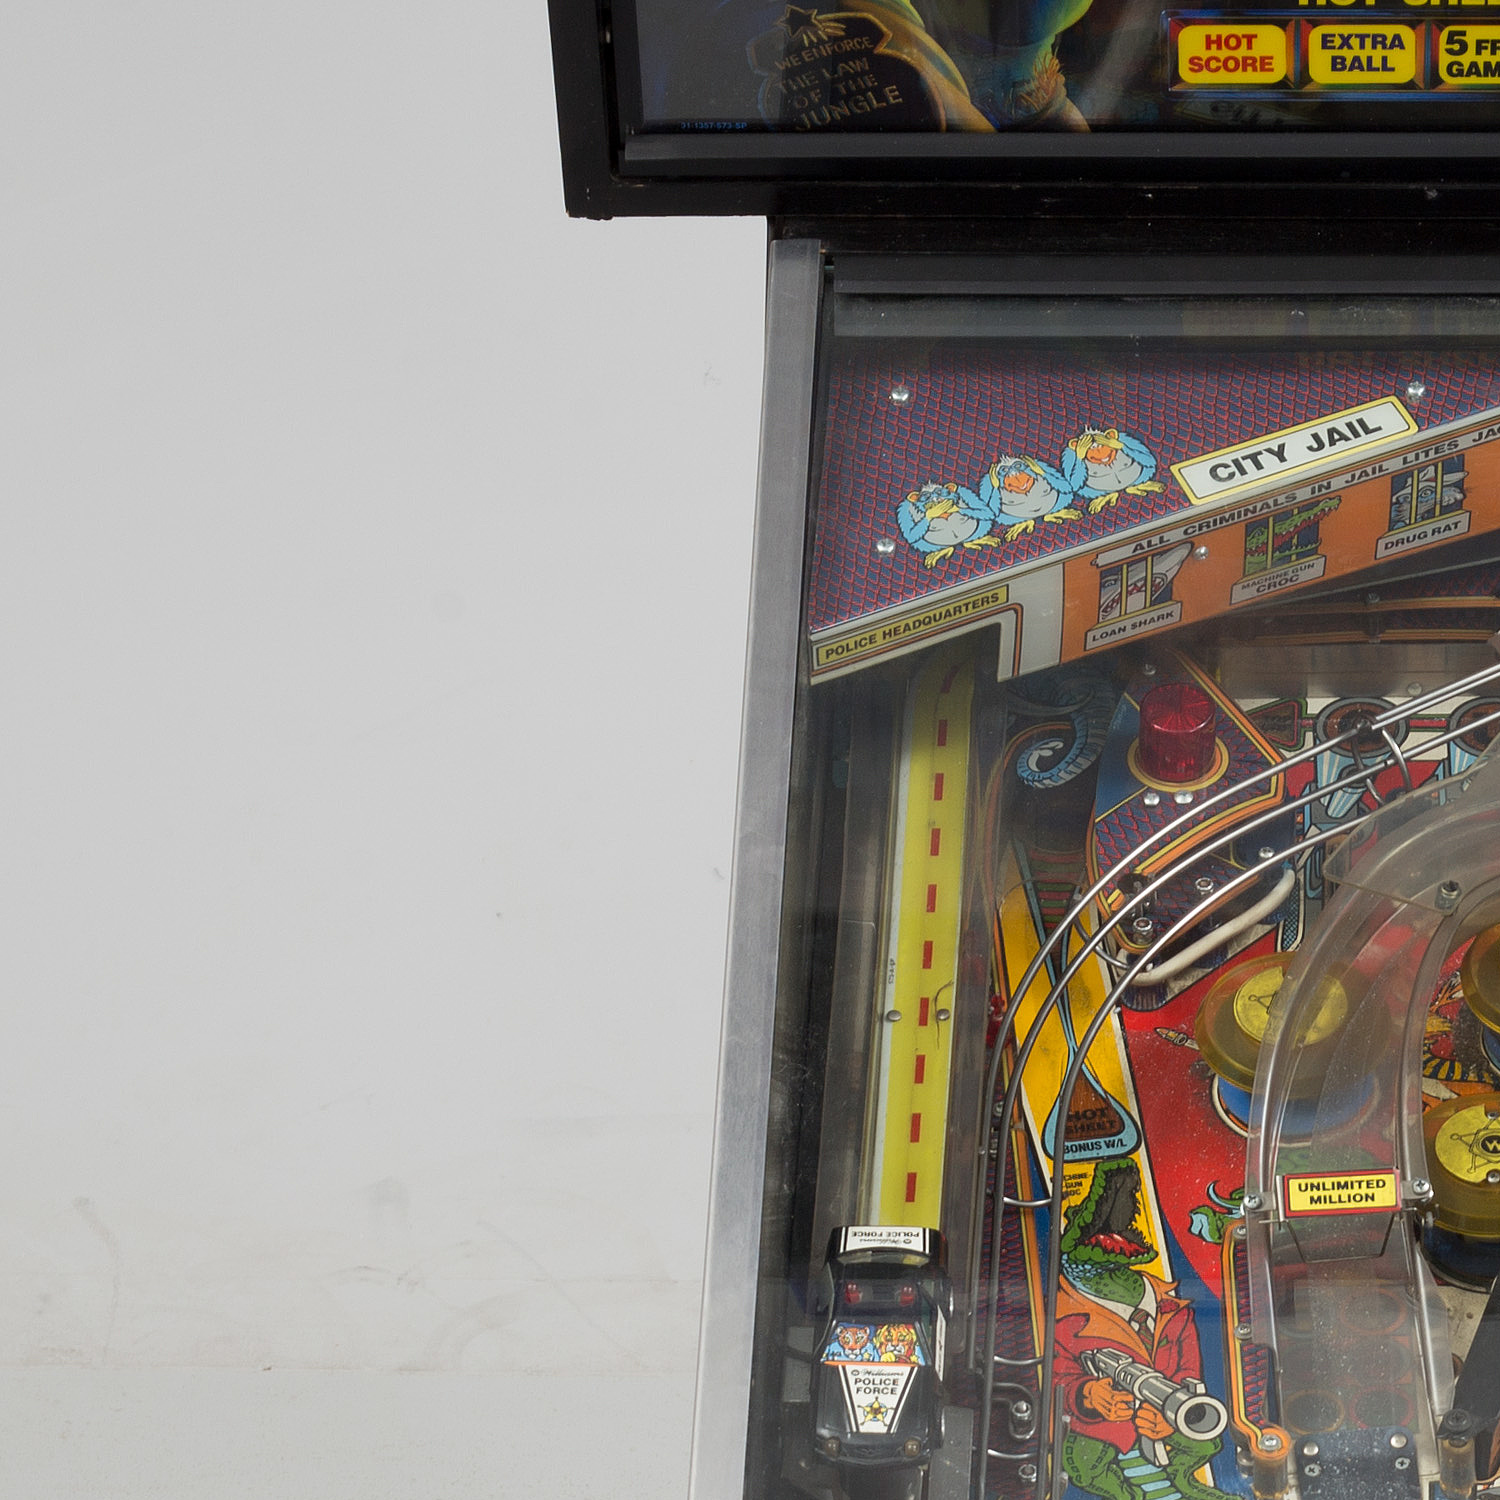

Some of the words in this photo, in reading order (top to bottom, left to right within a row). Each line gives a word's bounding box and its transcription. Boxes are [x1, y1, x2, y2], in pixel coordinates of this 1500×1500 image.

[801, 36, 875, 63] ENFORCE
[1205, 34, 1258, 51] HOT
[1321, 33, 1406, 51] EXTRA
[1444, 30, 1469, 57] 5
[822, 57, 871, 79] LAW
[1188, 55, 1275, 73] SCORE
[1330, 55, 1396, 73] BALL
[796, 84, 903, 130] JUNGLE
[1208, 442, 1288, 484] CITY
[1306, 416, 1384, 454] JAIL
[1131, 534, 1171, 554] ALL
[1182, 490, 1298, 537] CRIMINALS
[1310, 479, 1333, 495] IN
[1344, 462, 1390, 487] JAIL
[1402, 439, 1460, 468] LITES
[1384, 530, 1428, 552] DRUG
[1430, 519, 1463, 538] RAT
[1240, 571, 1286, 592] MACHINE
[1287, 561, 1316, 578] GUN
[1255, 572, 1301, 595] CROC
[825, 632, 878, 661] POLICE
[882, 591, 1000, 640] HEADQUARTERS
[1091, 624, 1127, 644] LOAN
[1129, 608, 1176, 631] SHARK
[1064, 1140, 1103, 1155] BONUS
[1104, 1138, 1128, 1150] W/L
[1297, 1178, 1387, 1194] UNLIMITED
[1308, 1191, 1376, 1206] MILLION
[853, 1377, 900, 1388] POLICE
[855, 1386, 898, 1396] FORCE
